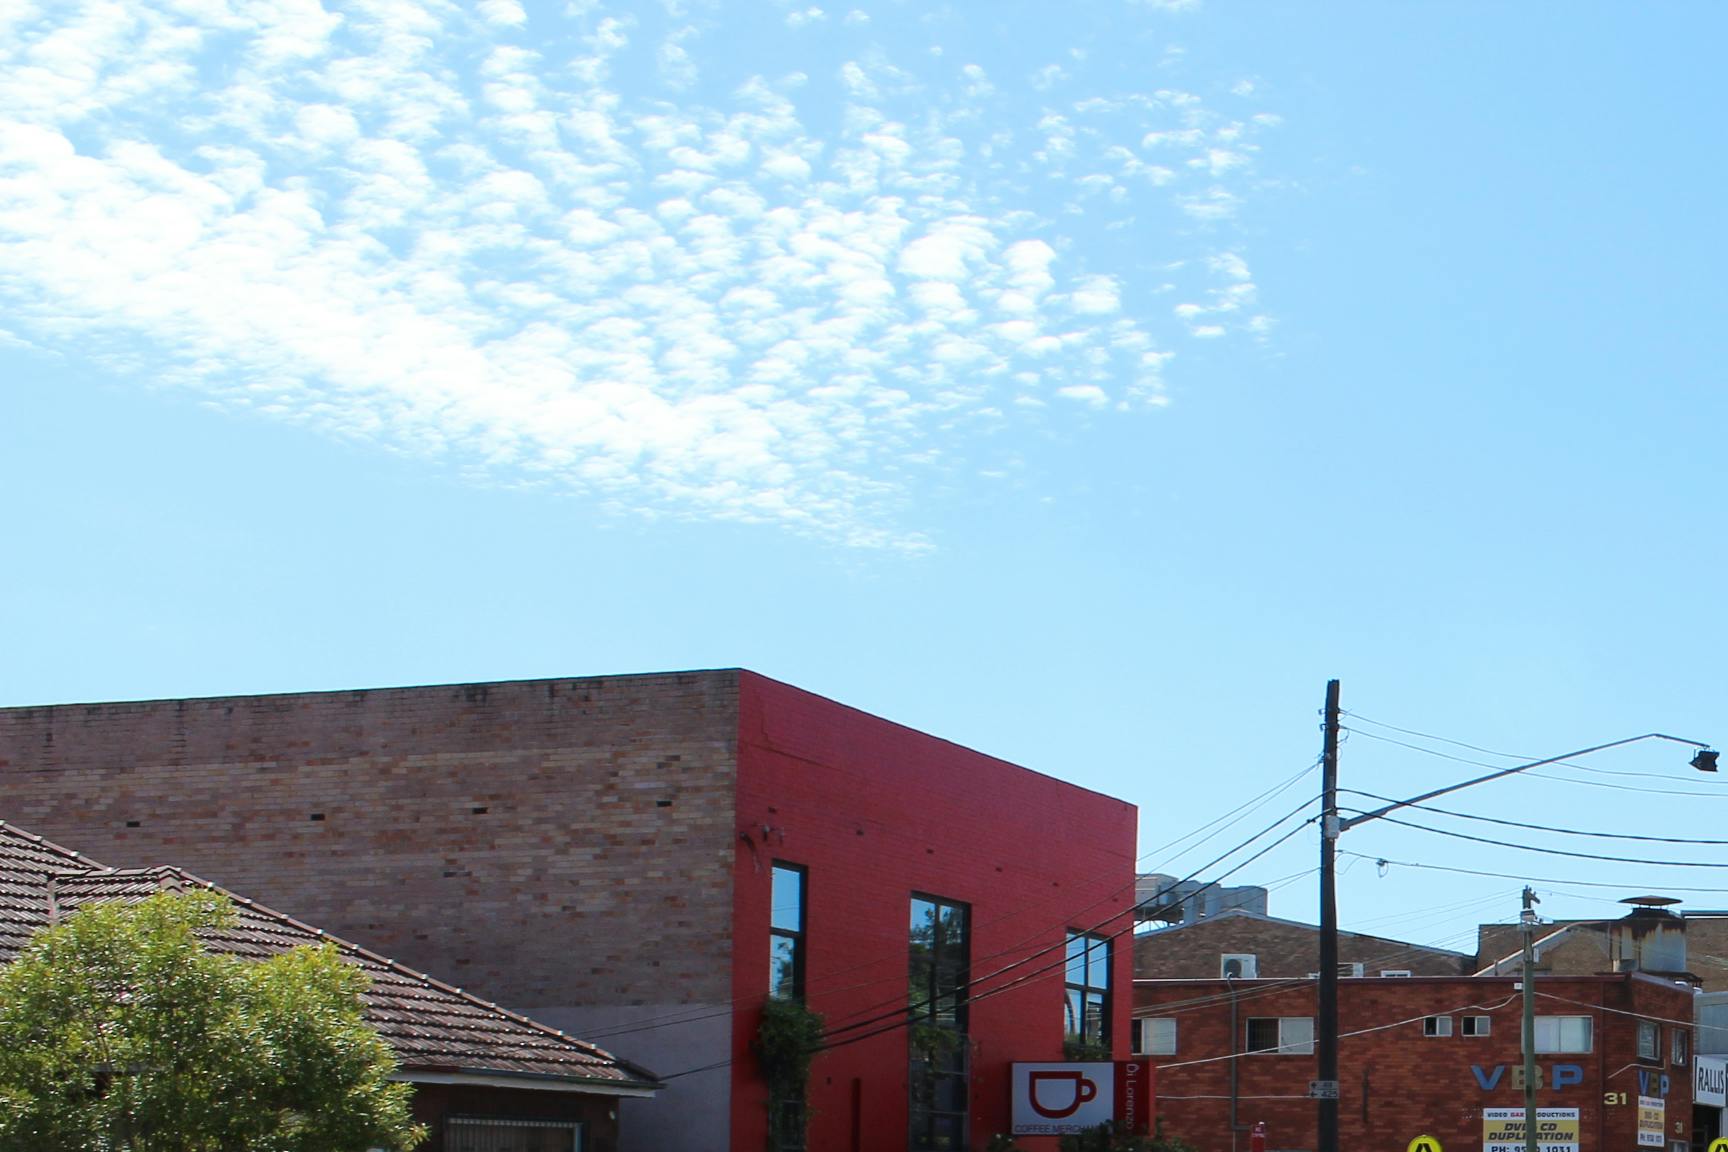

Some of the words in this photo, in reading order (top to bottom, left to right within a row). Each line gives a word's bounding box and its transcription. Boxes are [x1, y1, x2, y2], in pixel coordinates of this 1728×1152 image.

[1697, 1067, 1724, 1095] RALLIS
[1604, 1093, 1628, 1105] 31
[1014, 1124, 1053, 1133] COFFEE
[1540, 1123, 1557, 1132] CD
[1488, 1132, 1575, 1141] DUPLIATION
